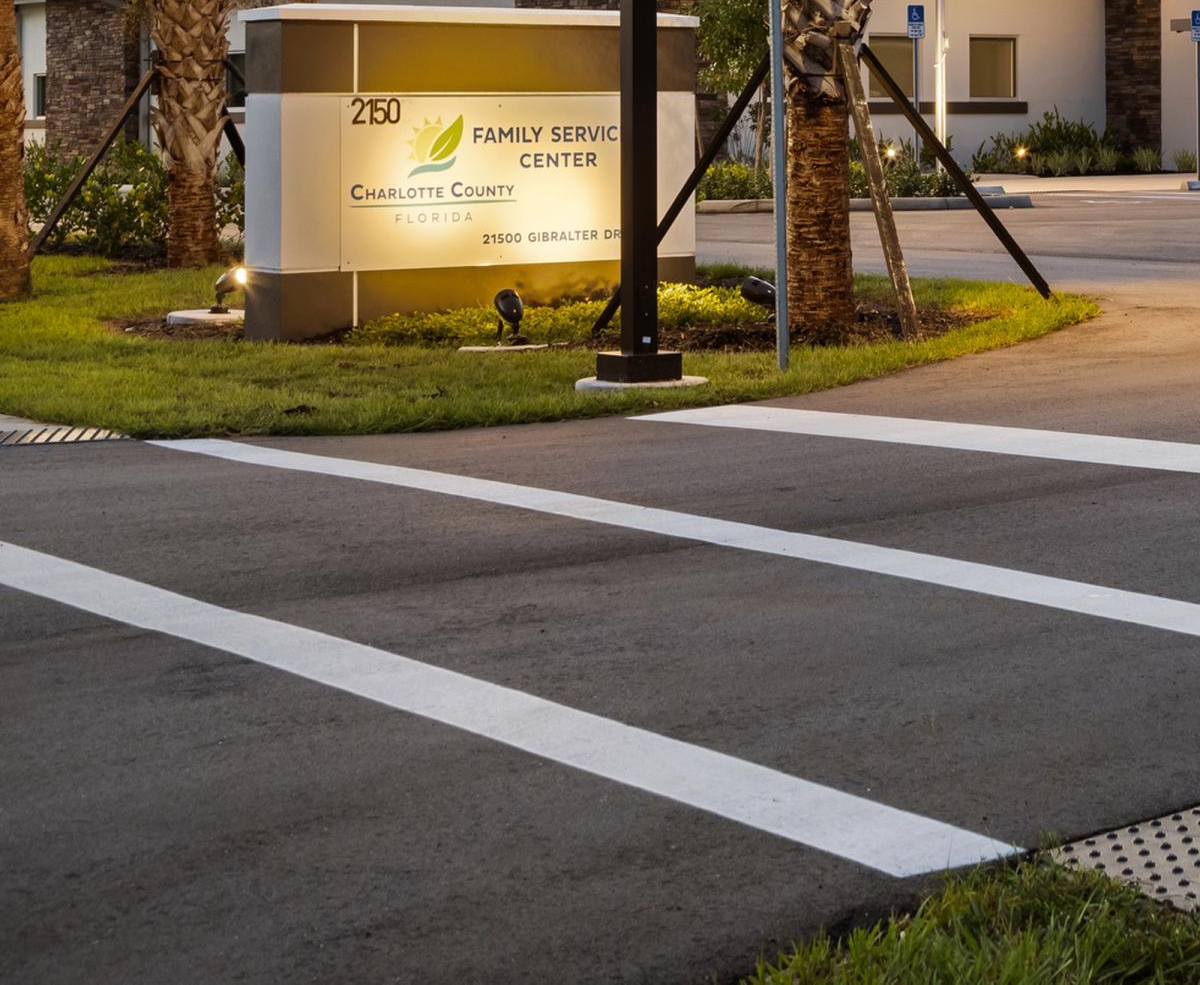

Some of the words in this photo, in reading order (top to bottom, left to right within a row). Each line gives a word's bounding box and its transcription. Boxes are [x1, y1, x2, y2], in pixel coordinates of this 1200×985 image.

[351, 98, 401, 125] 2150
[473, 126, 543, 144] FAMILY
[551, 125, 620, 143] SERVIC
[519, 152, 598, 168] CENTER
[350, 184, 445, 200] CHARLOTTE
[451, 182, 515, 198] COUNTY
[395, 212, 473, 224] FLORIDA
[482, 233, 522, 245] 21500
[528, 230, 598, 243] GIBRALTER
